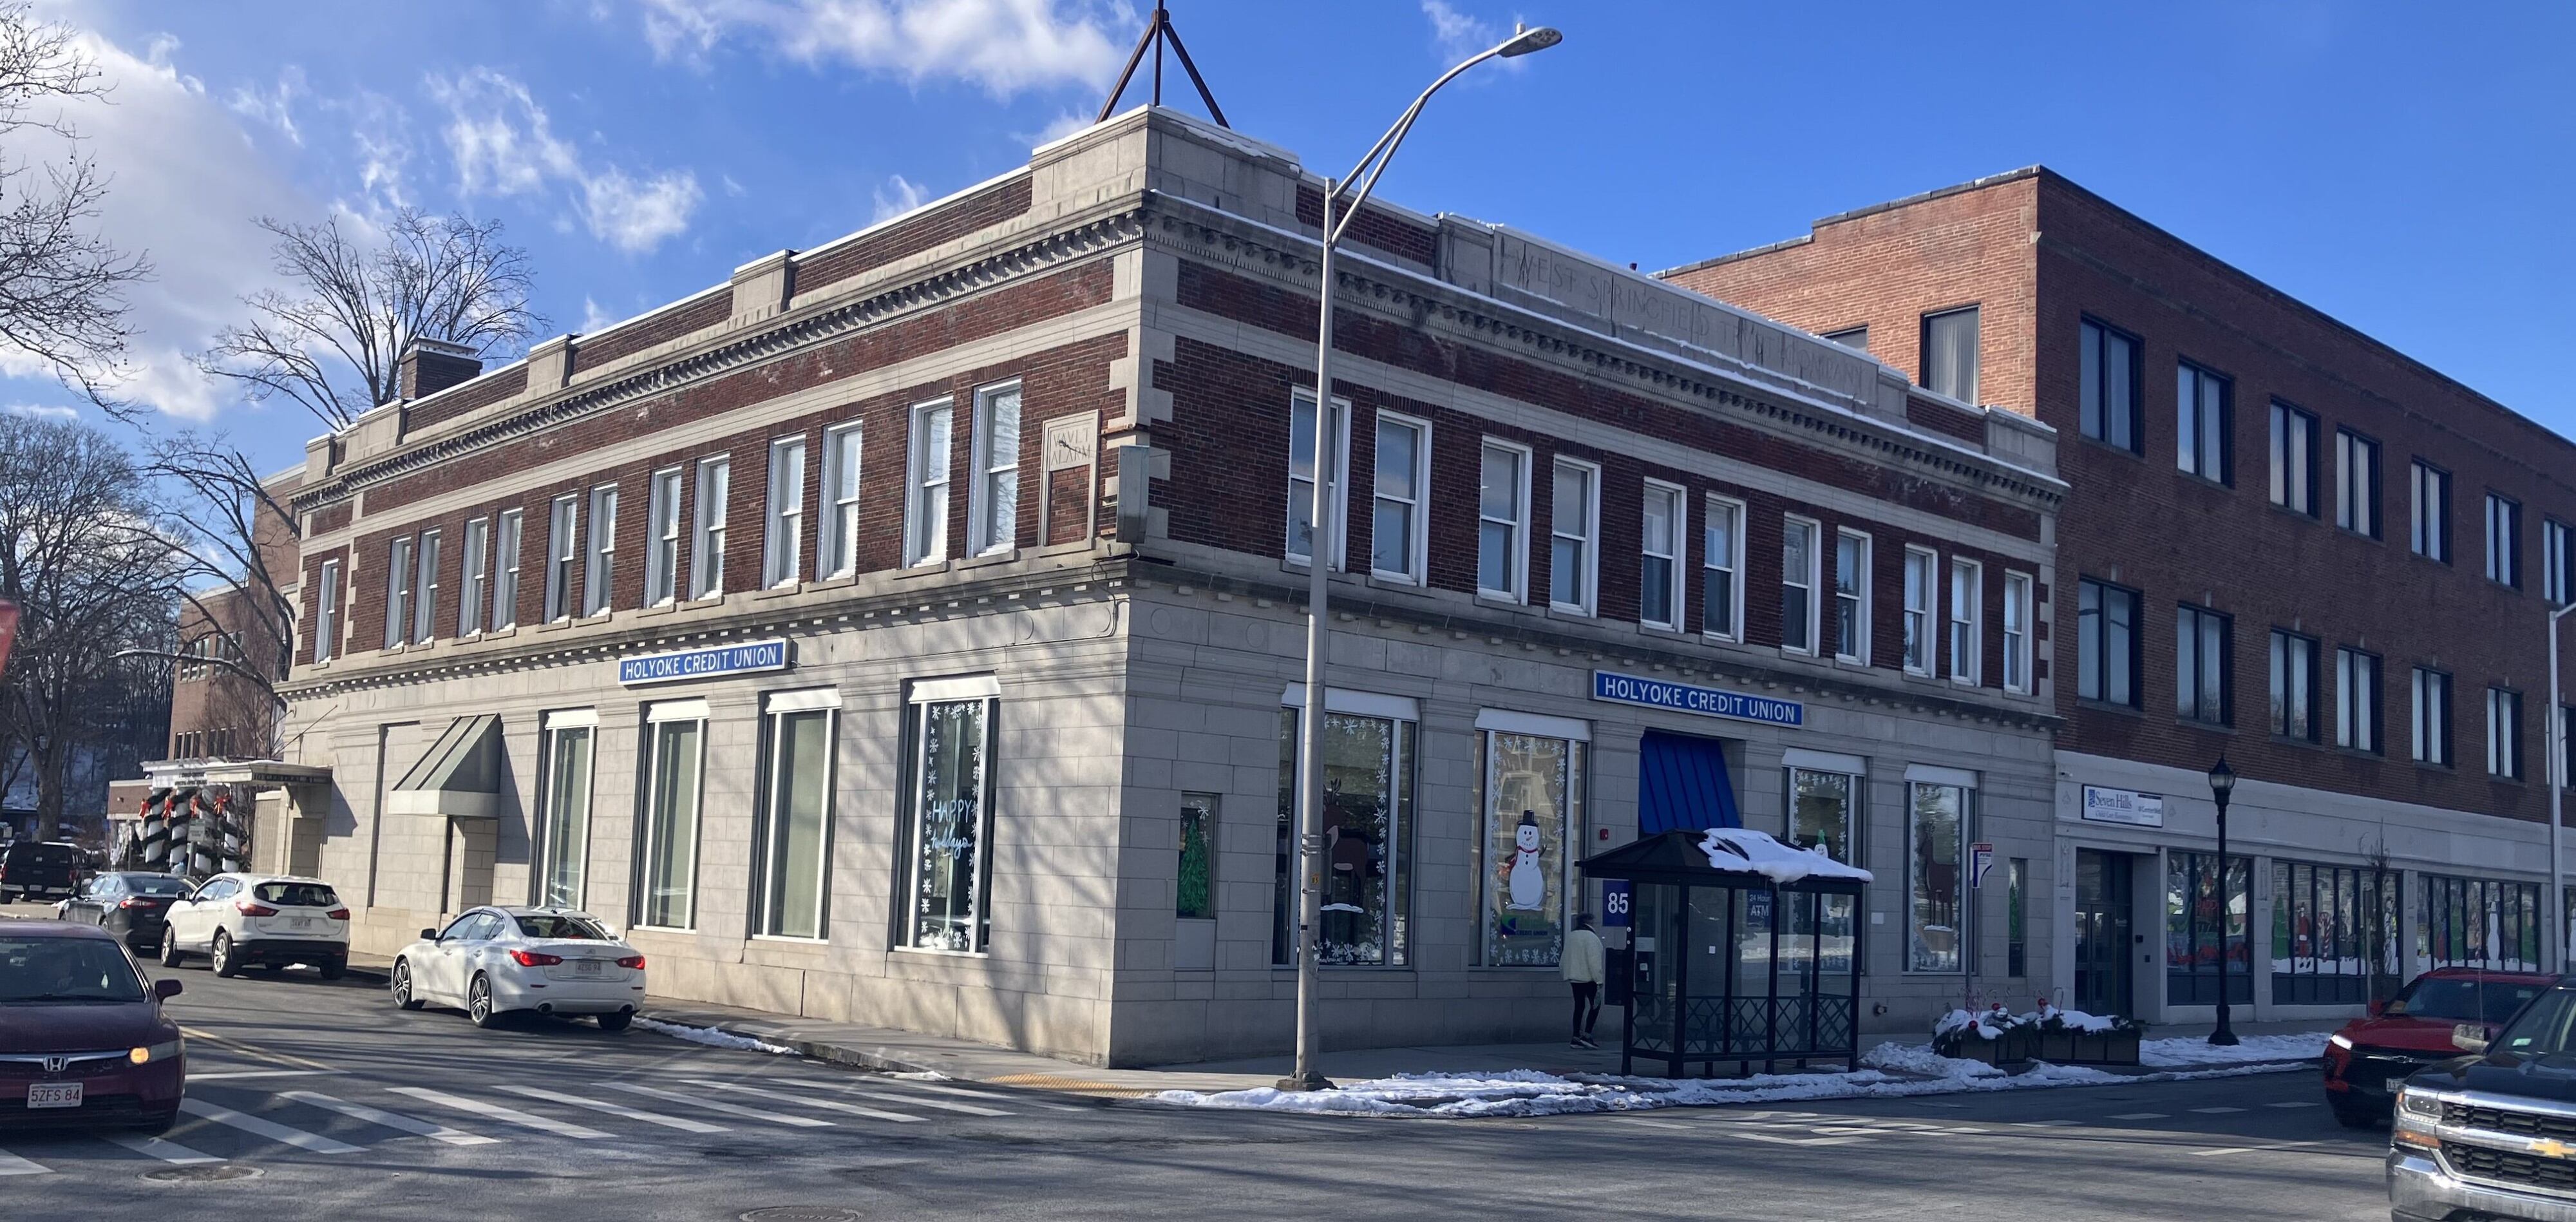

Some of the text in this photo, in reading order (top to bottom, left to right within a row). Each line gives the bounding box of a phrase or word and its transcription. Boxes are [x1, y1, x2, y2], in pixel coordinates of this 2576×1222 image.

[1050, 444, 1090, 466] ALARM
[625, 646, 777, 680] HOLYOKE CREDIT UNION
[1605, 677, 1795, 722] HOLYOKE CREDIT UNION
[2096, 791, 2133, 809] Seven Hills
[932, 799, 972, 823] HAPPY
[1608, 893, 1628, 913] 85
[1750, 905, 1769, 916] ATM
[31, 1089, 79, 1102] 5ZFS 84
